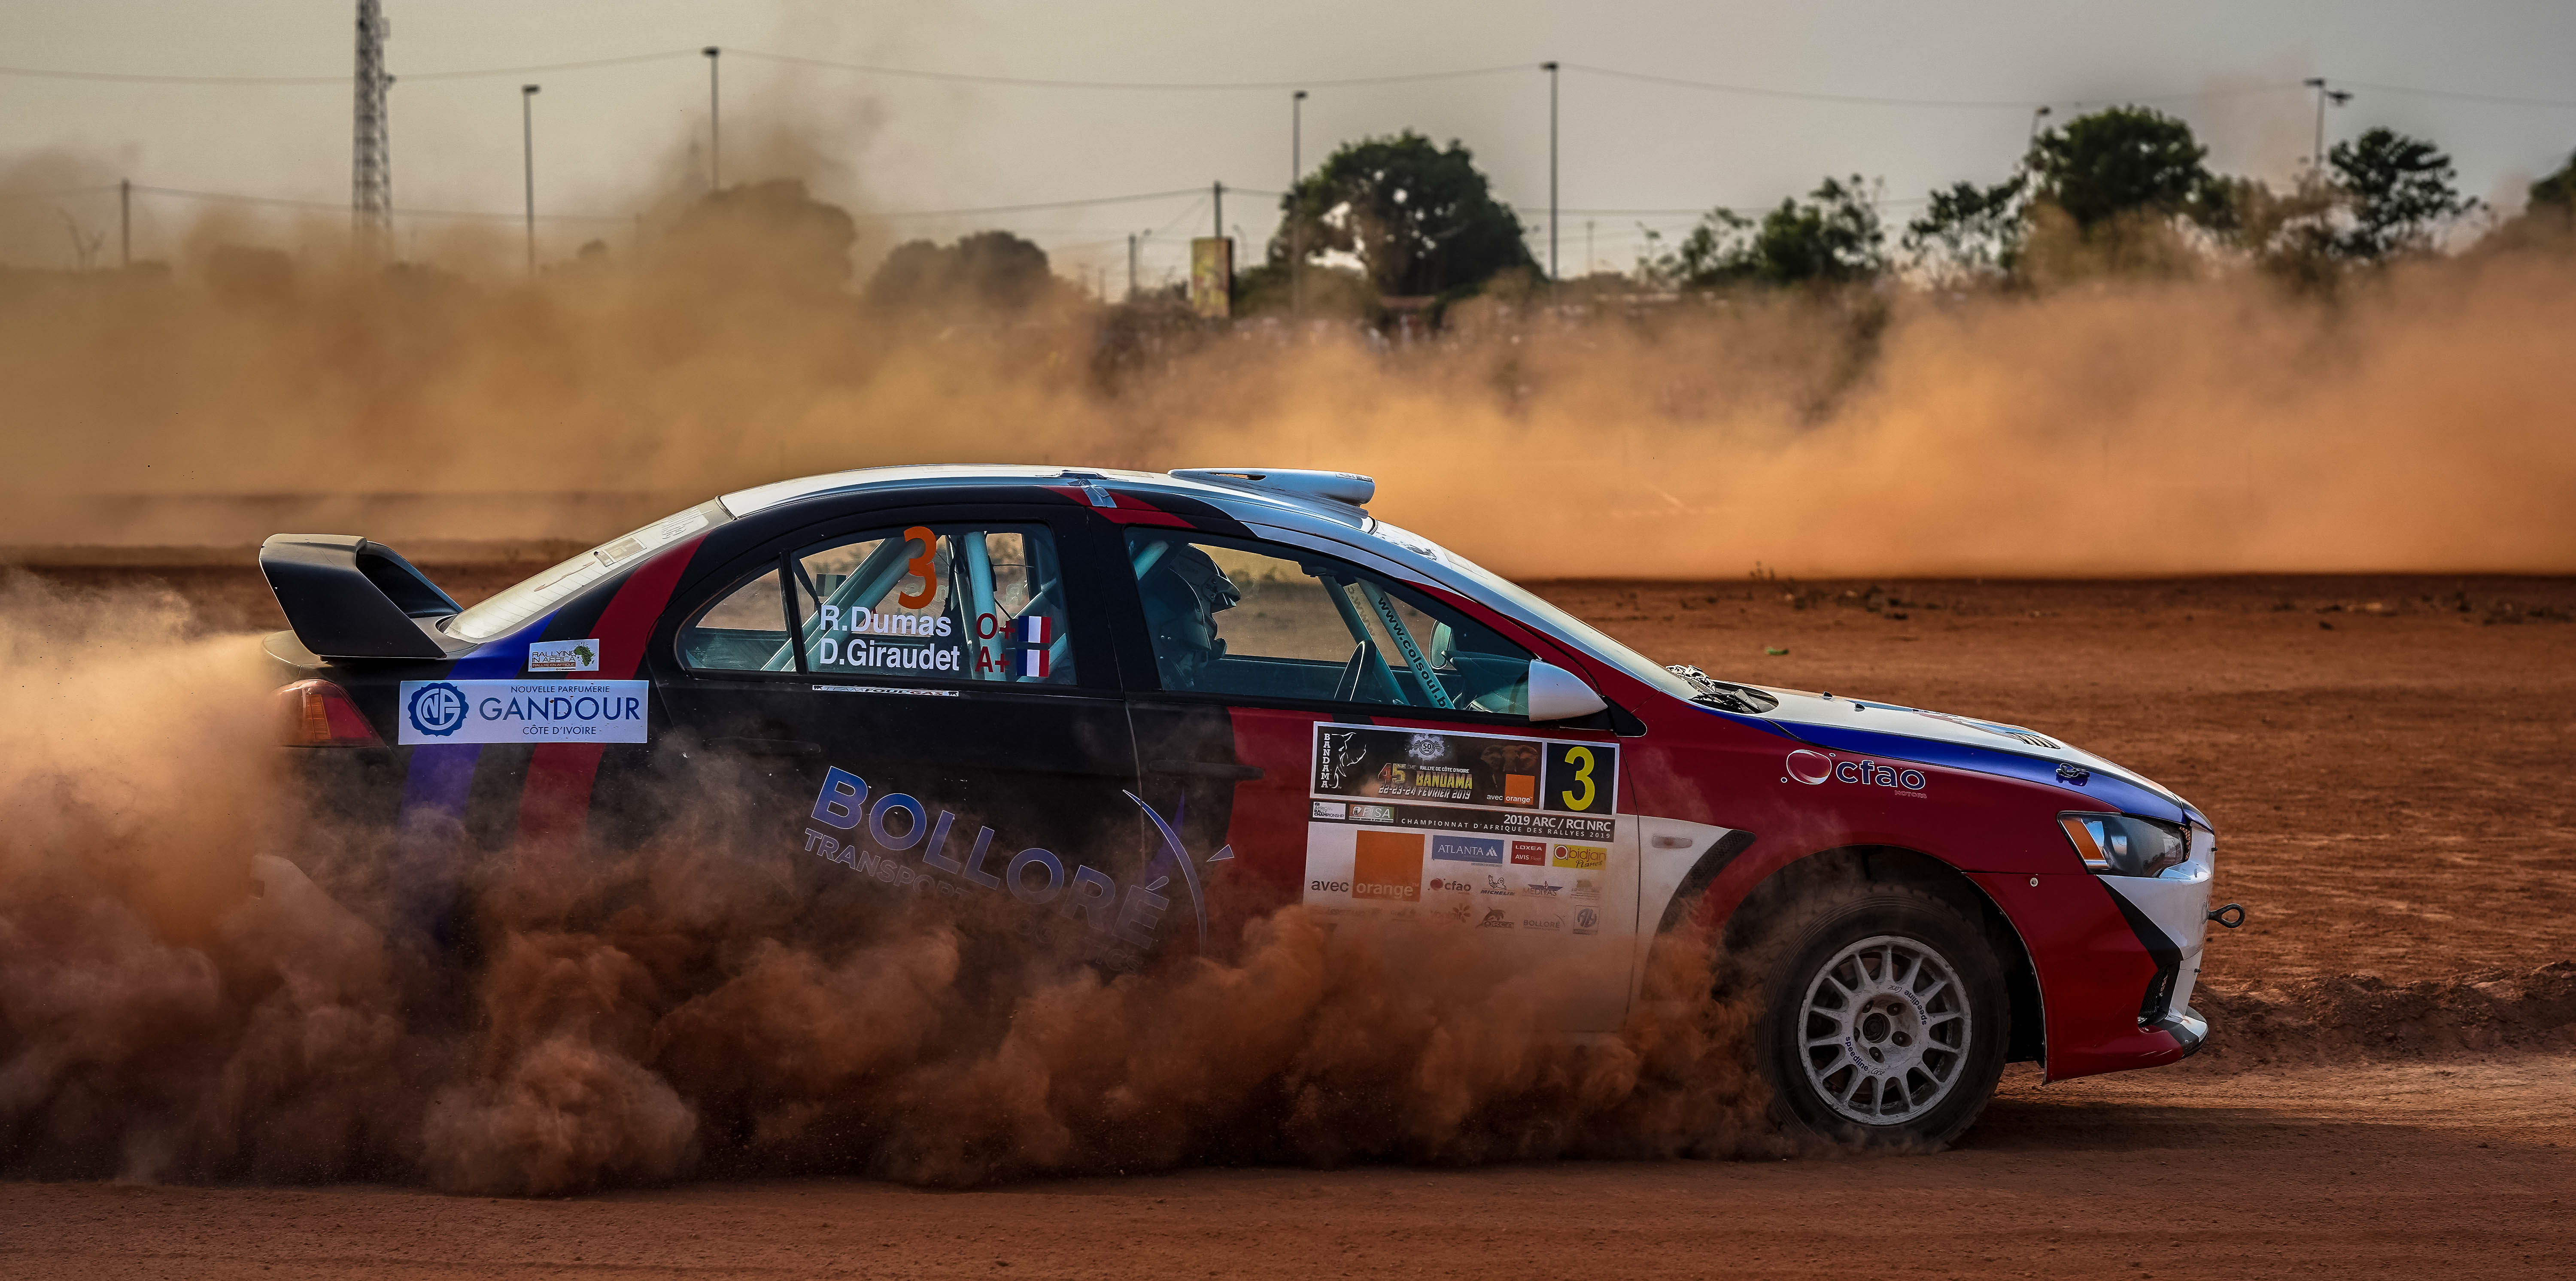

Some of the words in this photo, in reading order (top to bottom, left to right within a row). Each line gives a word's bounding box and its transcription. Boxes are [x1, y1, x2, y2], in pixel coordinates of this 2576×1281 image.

[897, 526, 937, 610] 3
[820, 604, 952, 637] R.Dumas
[819, 638, 960, 671] D.Giraudet
[479, 697, 640, 721] GANDOUR
[522, 724, 549, 735] CÔTE
[552, 726, 596, 735] D'IVOIRE
[1321, 733, 1331, 788] BANDAMA
[1378, 763, 1406, 785] 45
[1416, 771, 1473, 789] BANDAMA
[1562, 746, 1595, 811] 3
[1835, 759, 1926, 790] cfao
[1452, 789, 1472, 800] 2019
[1894, 790, 1927, 799] MOTORS
[1401, 818, 1469, 828] CHAMPIONNAT
[1503, 814, 1531, 826] 2019
[1532, 816, 1556, 828] ARC
[1566, 819, 1584, 830] RCI
[1587, 820, 1611, 832] NRC
[811, 765, 1170, 950] BOLLORÉ
[1438, 844, 1484, 856] ATLANTA
[1311, 880, 1349, 892] avec
[1444, 880, 1472, 892] cfao
[1904, 990, 1928, 1025] speedline
[1845, 1036, 1869, 1071] speedline
